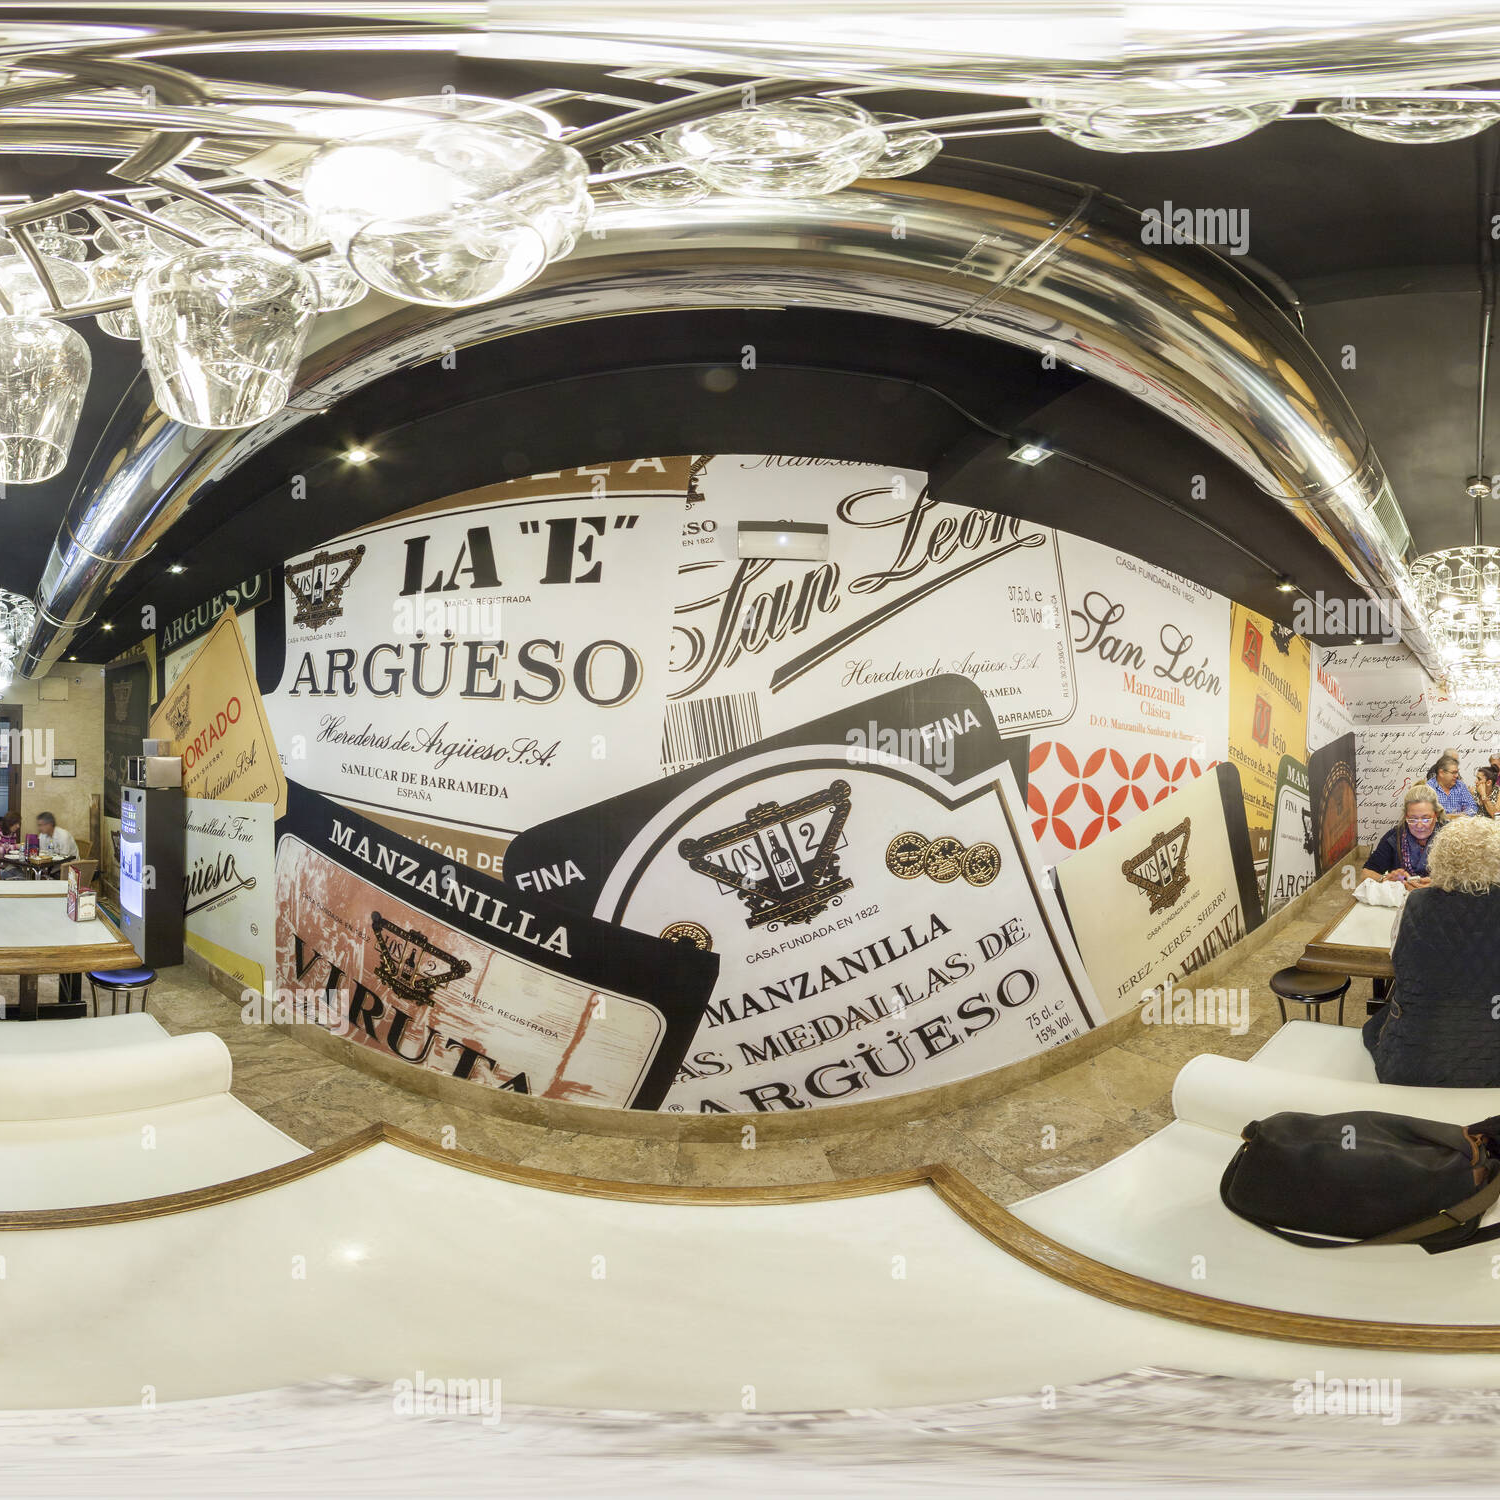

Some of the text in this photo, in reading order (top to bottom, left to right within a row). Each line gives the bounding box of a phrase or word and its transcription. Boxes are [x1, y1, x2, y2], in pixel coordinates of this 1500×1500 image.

[399, 515, 639, 597] LA "E"
[695, 536, 715, 546] 1822
[330, 567, 339, 586] 2
[1115, 555, 1137, 573] CASA
[1138, 566, 1171, 591] FUNDADA
[1172, 585, 1181, 596] EN
[444, 595, 532, 608] MARCA REGISTRADA
[1011, 608, 1029, 624] 15%
[1071, 591, 1145, 670] San
[1153, 623, 1221, 696] León
[288, 629, 644, 708] ARGÜESO
[841, 658, 923, 687] Herederos
[925, 658, 941, 676] de
[1123, 671, 1186, 707] Manzanilla
[998, 708, 1053, 725] BARRAMEDA
[1089, 714, 1109, 728] D.O.
[1110, 718, 1146, 734] Manzanilla
[1140, 700, 1171, 721] Clásica
[181, 696, 242, 777] ORTADO
[317, 714, 391, 751] Herederos
[390, 730, 412, 751] de
[412, 721, 508, 769] Argüeso
[919, 708, 982, 750] FINA
[341, 762, 509, 799] SANLUCAR DE BARRAMEDA
[396, 787, 433, 802] ESPAÑA
[1286, 764, 1309, 791] MAN
[1285, 799, 1298, 814] FINA
[799, 822, 820, 852] 2
[328, 818, 574, 958] MANZANILLA
[515, 858, 586, 893] FINA
[746, 904, 880, 965] CASA FUNDADA EN 1822
[1146, 926, 1161, 941] CASA
[1160, 905, 1183, 928] FUNDADA
[1117, 961, 1153, 999] JEREZ
[1160, 925, 1192, 961] XERES
[1197, 889, 1228, 925] SHERRY
[422, 960, 436, 977] 2
[703, 913, 952, 1029] MANZANILLA
[736, 952, 975, 1066] MEDALLAS
[975, 917, 1031, 963] DE
[462, 991, 560, 1040] MARCA REGISTRADA
[1025, 1013, 1041, 1030] 75
[1035, 1026, 1057, 1045] 15%
[1056, 1012, 1074, 1030] Vol.
